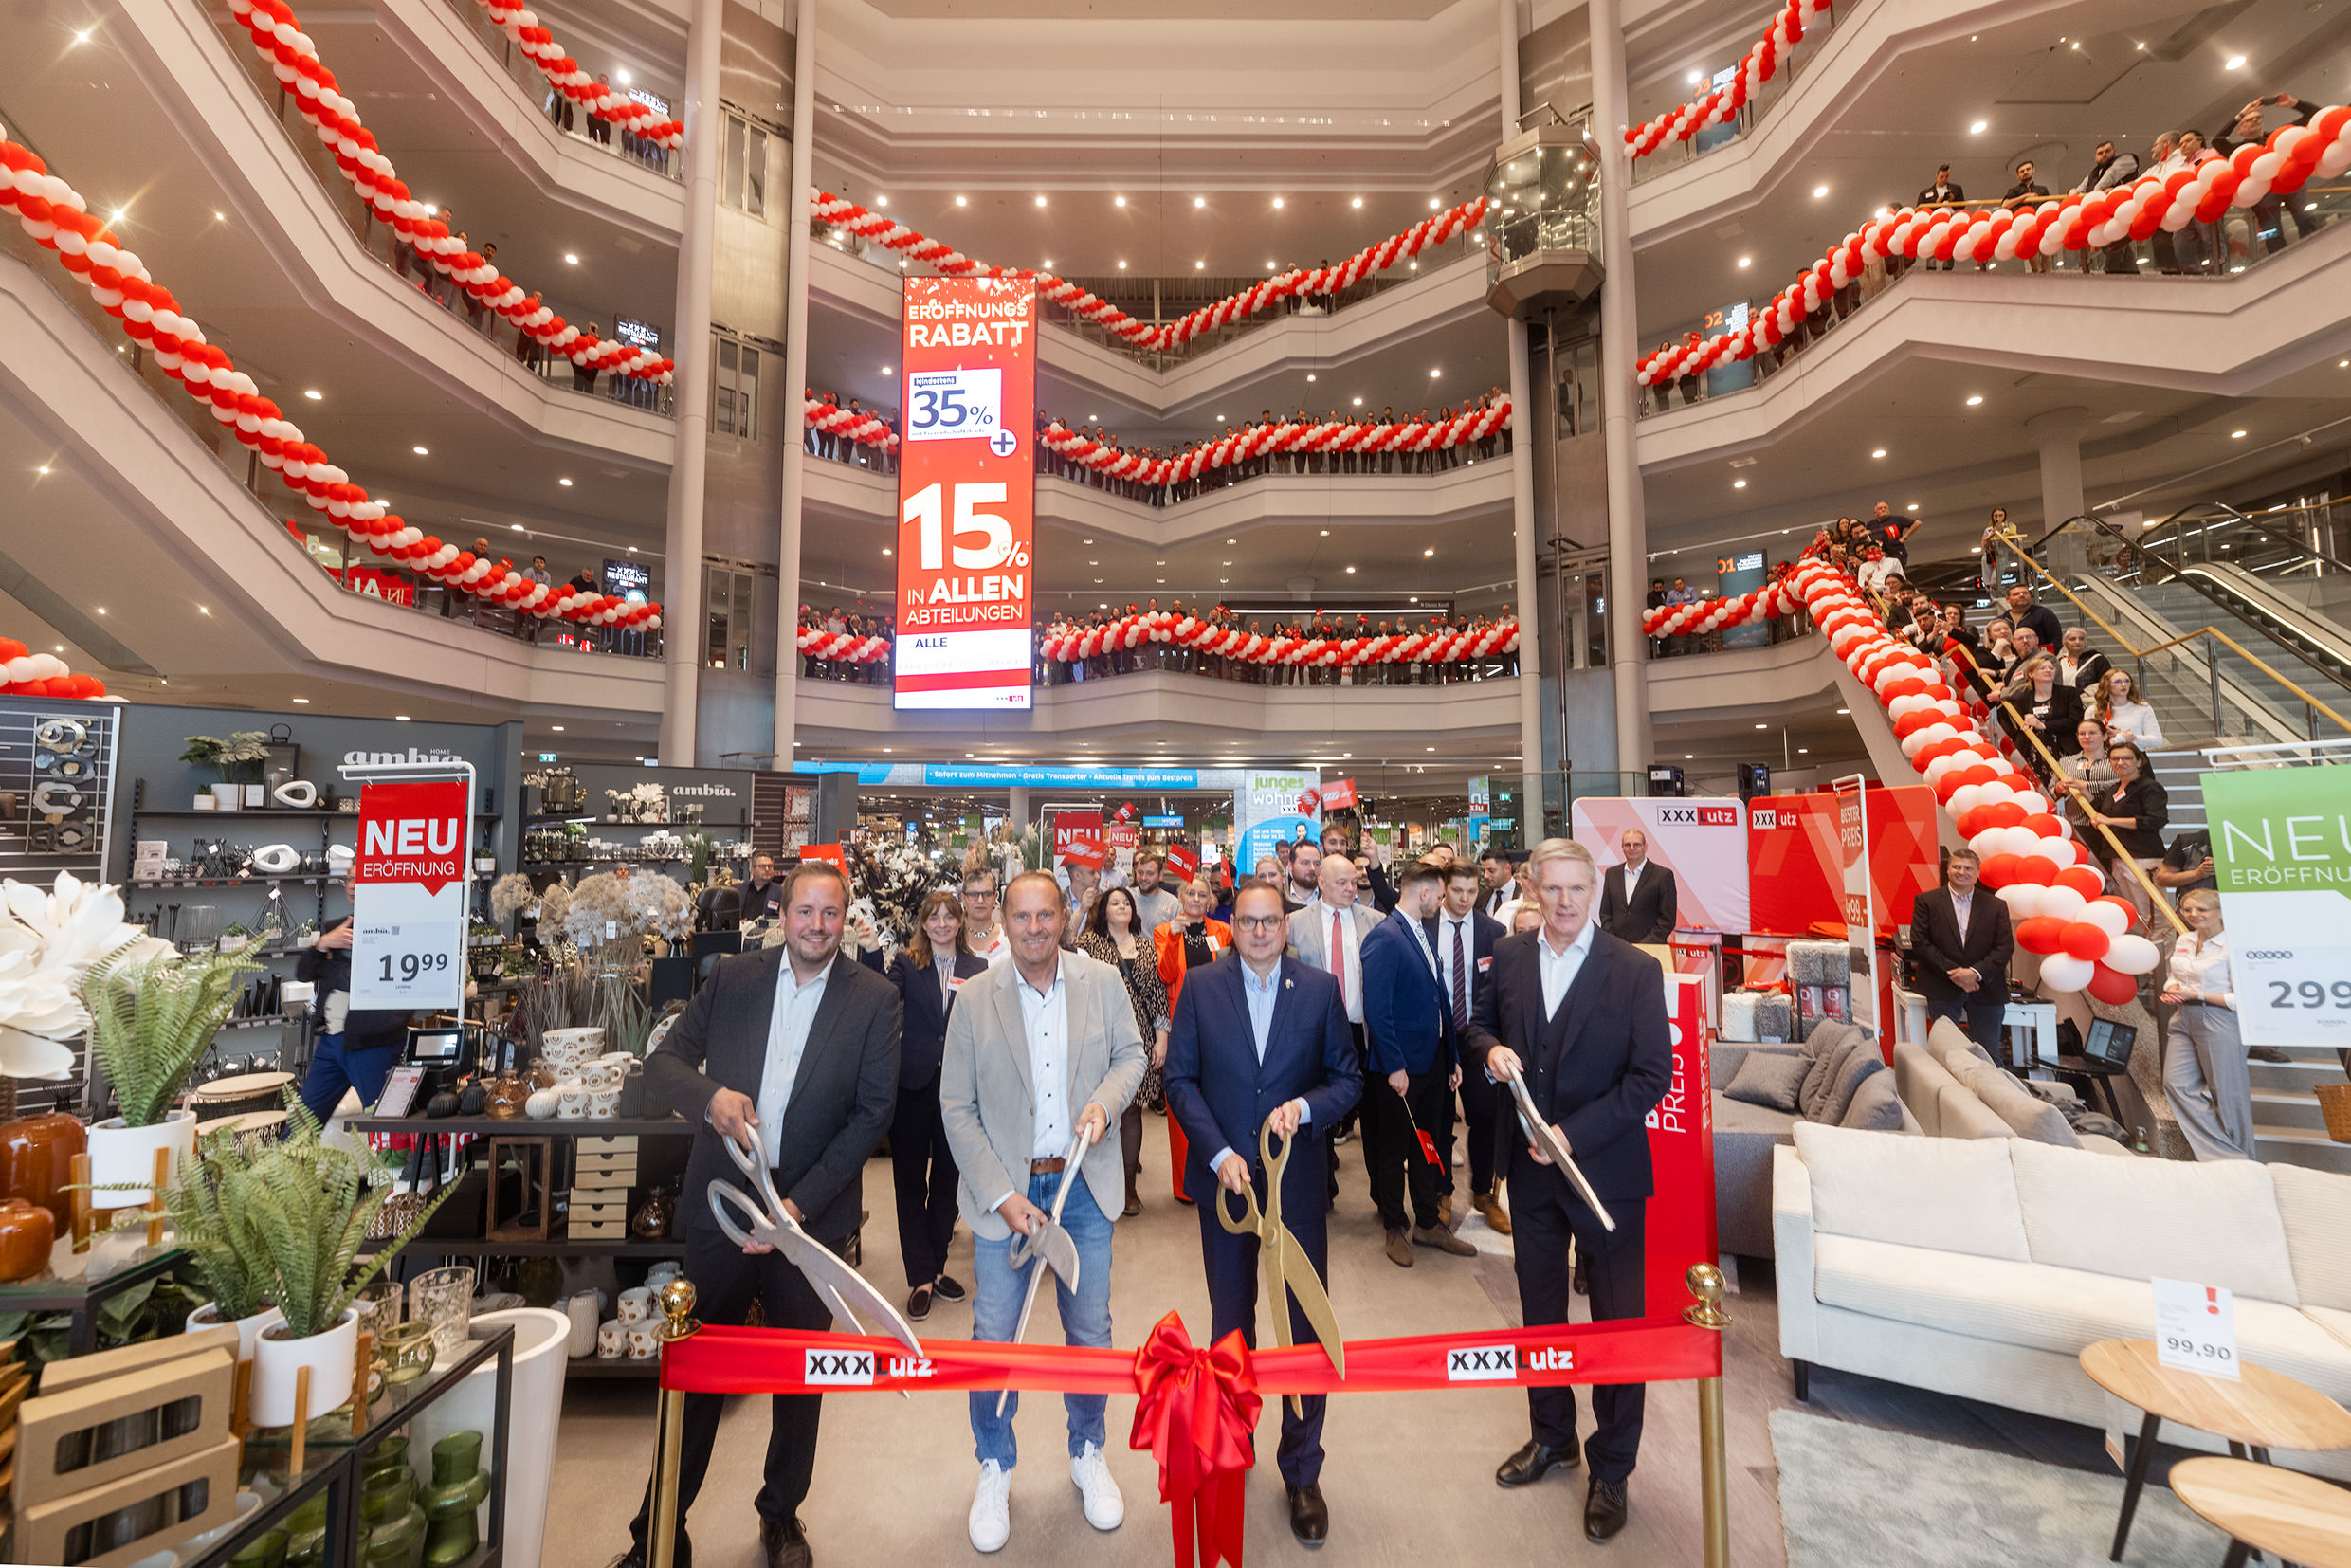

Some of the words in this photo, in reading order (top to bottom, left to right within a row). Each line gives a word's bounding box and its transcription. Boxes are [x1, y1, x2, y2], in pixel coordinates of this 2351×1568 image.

[907, 302, 1028, 319] ERÖFFNUNGS
[909, 321, 1029, 348] RABATT
[907, 588, 925, 605] IN
[928, 575, 1024, 604] ALLEN
[905, 605, 1023, 626] ABTEILUNGEN
[915, 637, 948, 648] ALLE
[1046, 773, 1087, 781] Transporter
[1252, 774, 1305, 792] junges
[1252, 791, 1303, 805] wohne
[1662, 810, 1733, 823] XXXLutz
[1755, 811, 1797, 826] XXXLutz
[365, 818, 458, 855] NEU
[1112, 833, 1133, 842] NEU
[1841, 828, 1863, 847] PREIS
[363, 861, 455, 878] ERÖFFNUNG
[809, 1354, 935, 1377] XXXLutz
[1451, 1347, 1574, 1371] XXXLutz
